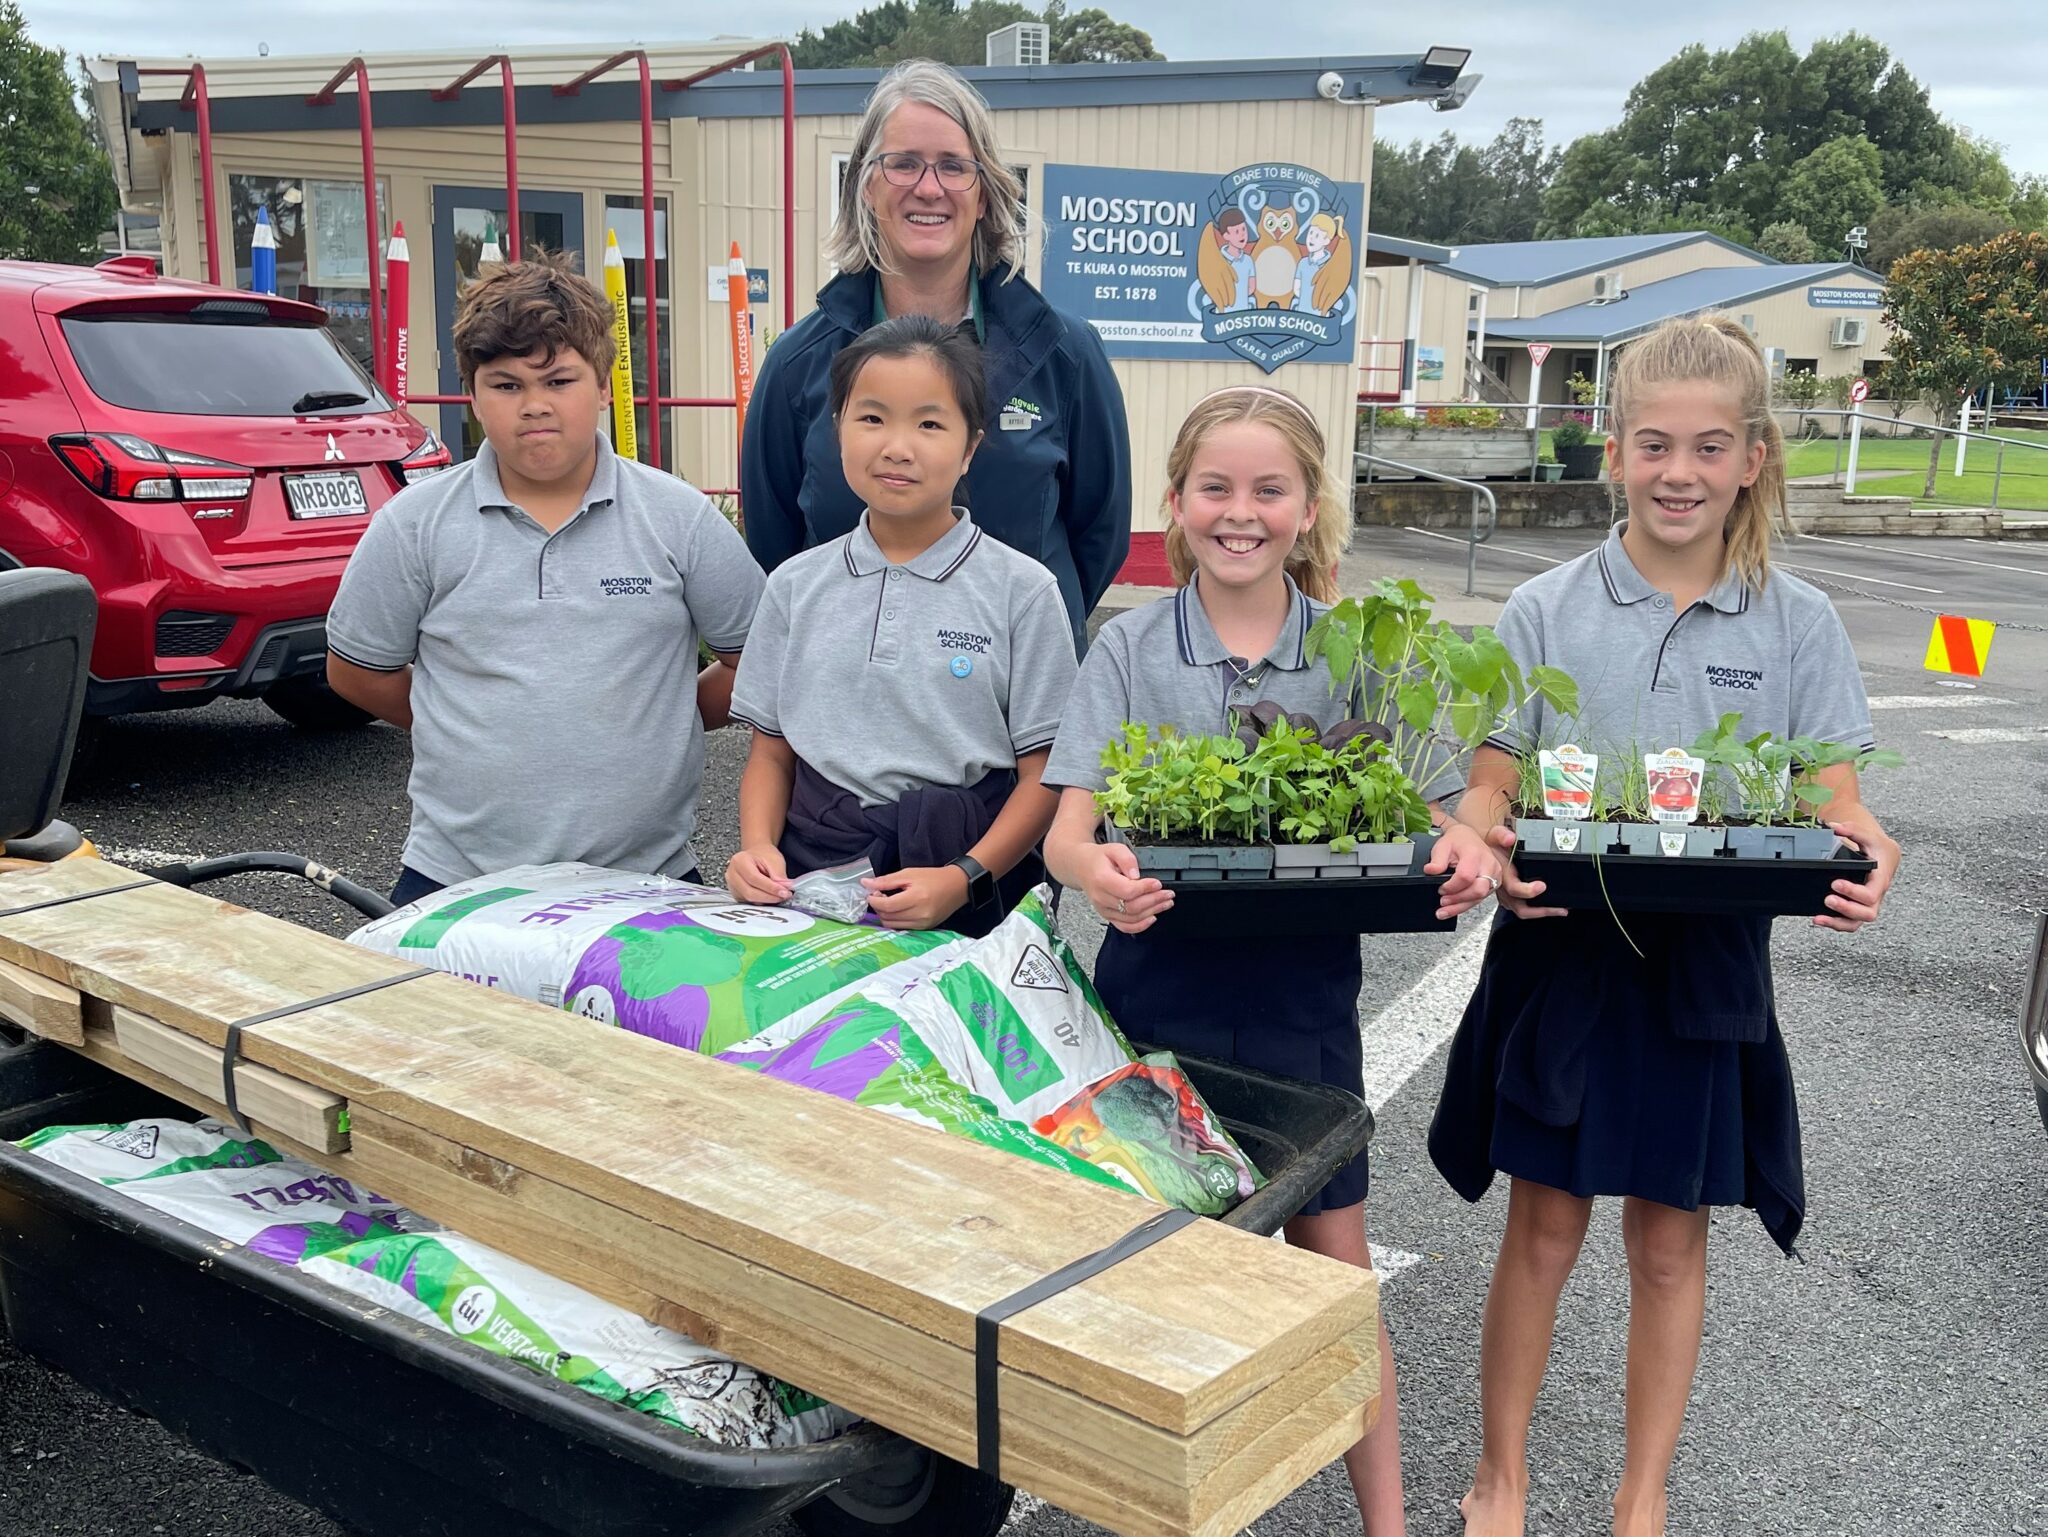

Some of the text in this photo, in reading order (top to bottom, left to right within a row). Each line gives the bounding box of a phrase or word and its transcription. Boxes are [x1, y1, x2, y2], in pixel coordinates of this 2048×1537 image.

[1232, 167, 1322, 188] DARE TO BE WISE
[1061, 195, 1197, 227] MOSSTON
[1071, 226, 1184, 257] SCHOOL
[1066, 261, 1187, 278] TE KURA O MOSSTON
[1094, 286, 1157, 301] EST. 1878
[1813, 290, 1842, 298] MOSSTON
[1843, 291, 1867, 299] SCHOOL
[616, 290, 629, 371] ENTHUSIASTIC
[1214, 315, 1328, 339] MOSSTON SCHOOL
[396, 327, 408, 372] ACTIVE
[736, 308, 750, 375] SUCCESSFUL
[1272, 340, 1305, 361] QUALITY
[397, 374, 406, 397] ARE
[621, 373, 631, 394] ARE
[741, 378, 751, 399] ARE
[623, 397, 635, 452] STUDENTS
[288, 480, 363, 511] NRB803
[600, 577, 653, 588] MOSSTON
[605, 586, 651, 596] SCHOOL
[937, 629, 992, 646] MOSSTON
[940, 639, 987, 654] SCHOOL
[1705, 665, 1763, 681] MOSSTON
[1709, 676, 1758, 691] SCHOOL
[709, 908, 774, 925] tui
[1027, 960, 1051, 984] CAUTION
[116, 1132, 151, 1149] CAUTION
[458, 1299, 486, 1326] tui
[487, 1314, 563, 1378] VEGETABLE
